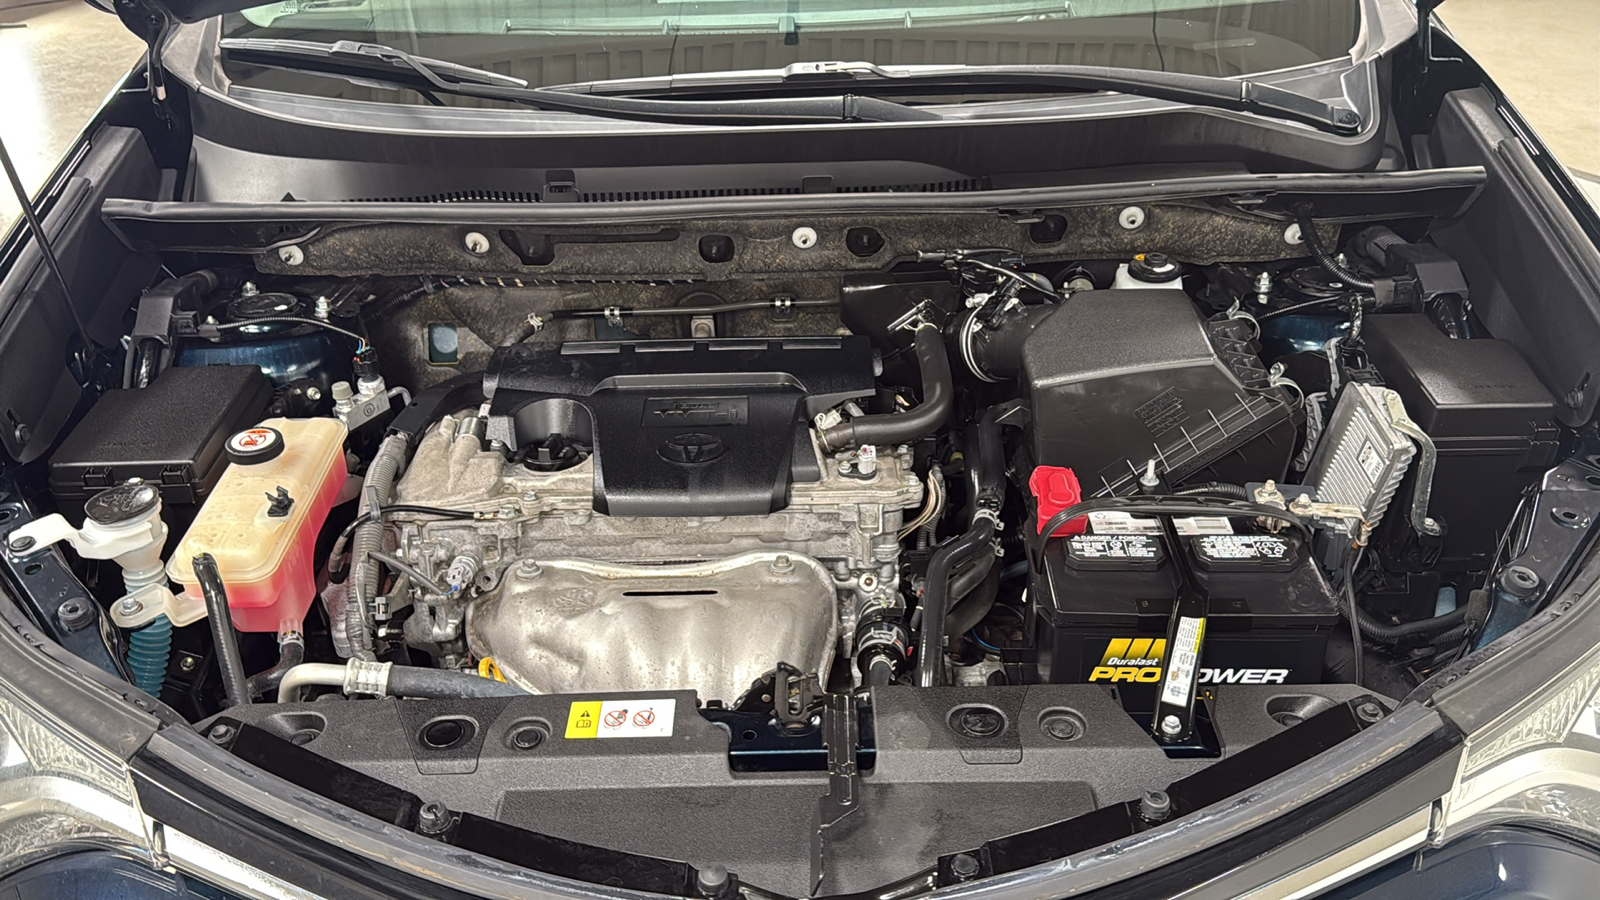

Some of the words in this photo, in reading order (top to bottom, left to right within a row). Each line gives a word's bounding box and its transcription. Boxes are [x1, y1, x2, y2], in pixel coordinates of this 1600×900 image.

[1107, 657, 1159, 666] Duralast
[1088, 667, 1162, 682] PRO
[1198, 668, 1289, 684] OWER
